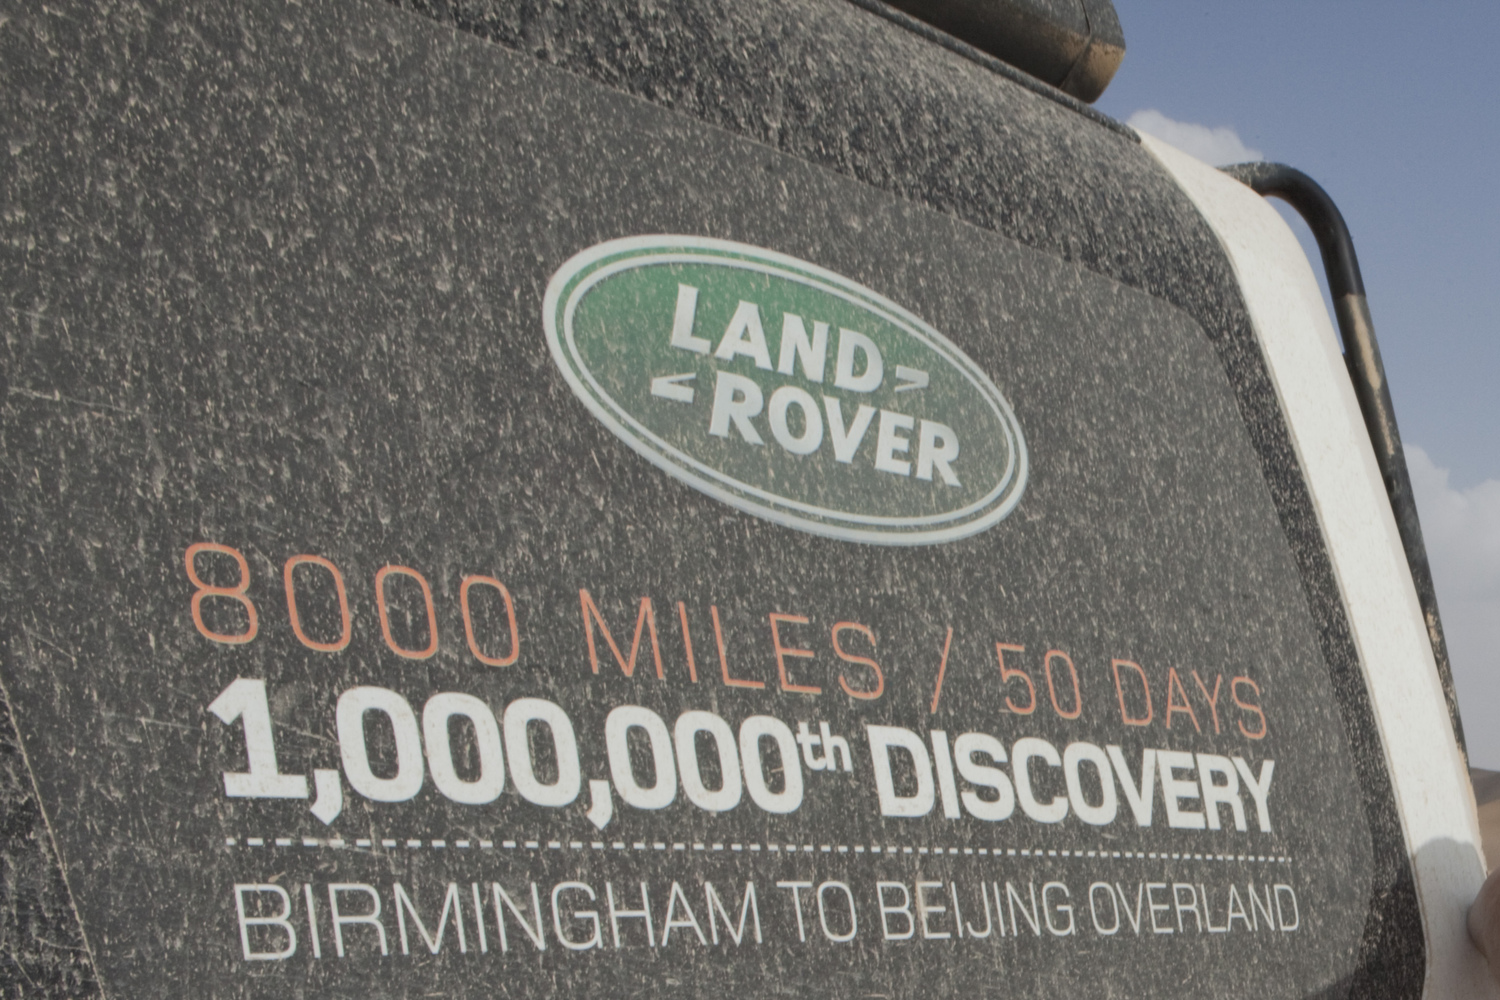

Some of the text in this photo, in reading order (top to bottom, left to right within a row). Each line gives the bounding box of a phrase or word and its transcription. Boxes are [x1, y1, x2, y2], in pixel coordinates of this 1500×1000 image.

[671, 283, 884, 392] LAND
[708, 370, 962, 487] ROVER
[185, 542, 520, 667] 8000
[579, 588, 885, 701] MILES
[996, 642, 1082, 720] 50
[1112, 658, 1268, 740] DAYS
[208, 677, 1275, 833] 1,000,000th DISCOVERY
[234, 880, 1300, 962] BIRMINGHAM TO BEIJING OVERLAND
